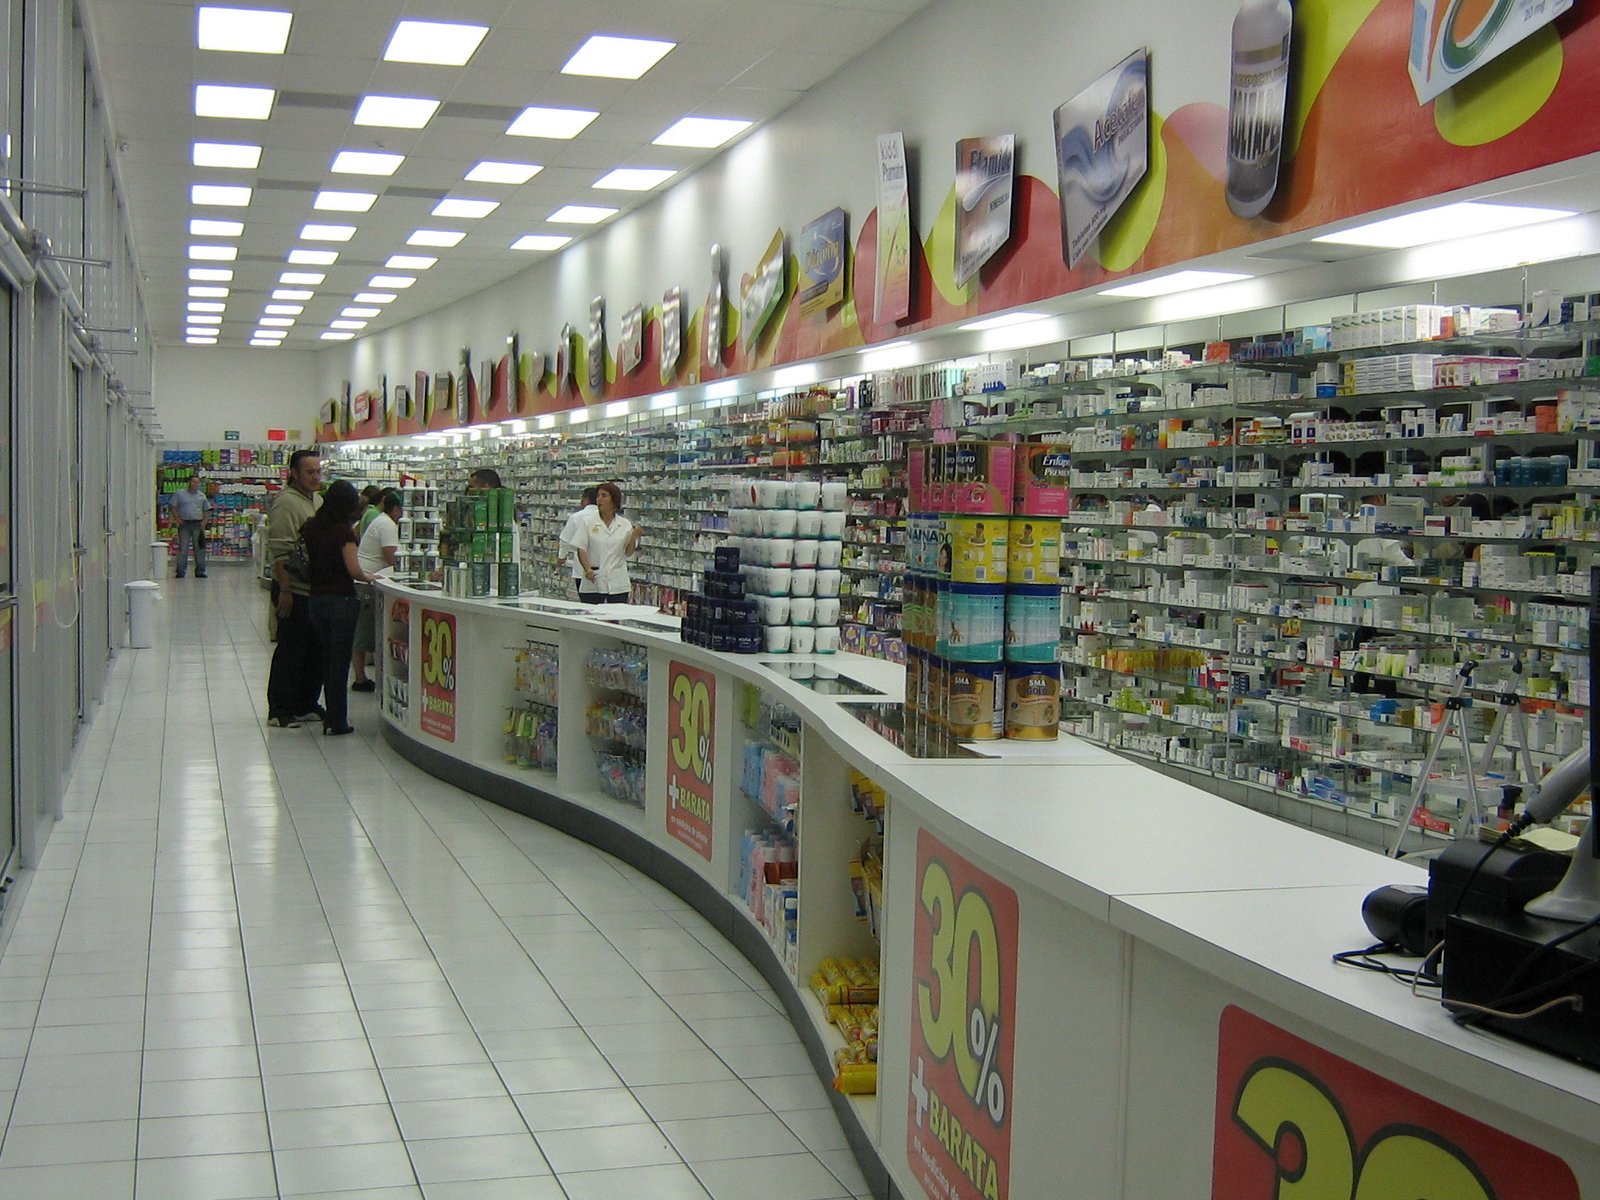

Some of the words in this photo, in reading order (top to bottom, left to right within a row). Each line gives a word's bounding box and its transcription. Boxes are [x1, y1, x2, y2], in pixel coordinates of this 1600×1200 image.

[422, 616, 455, 690] 30%
[672, 674, 713, 784] 30%
[680, 786, 711, 825] BARATA
[917, 861, 1006, 1124] 30%
[929, 1088, 999, 1200] BARATA
